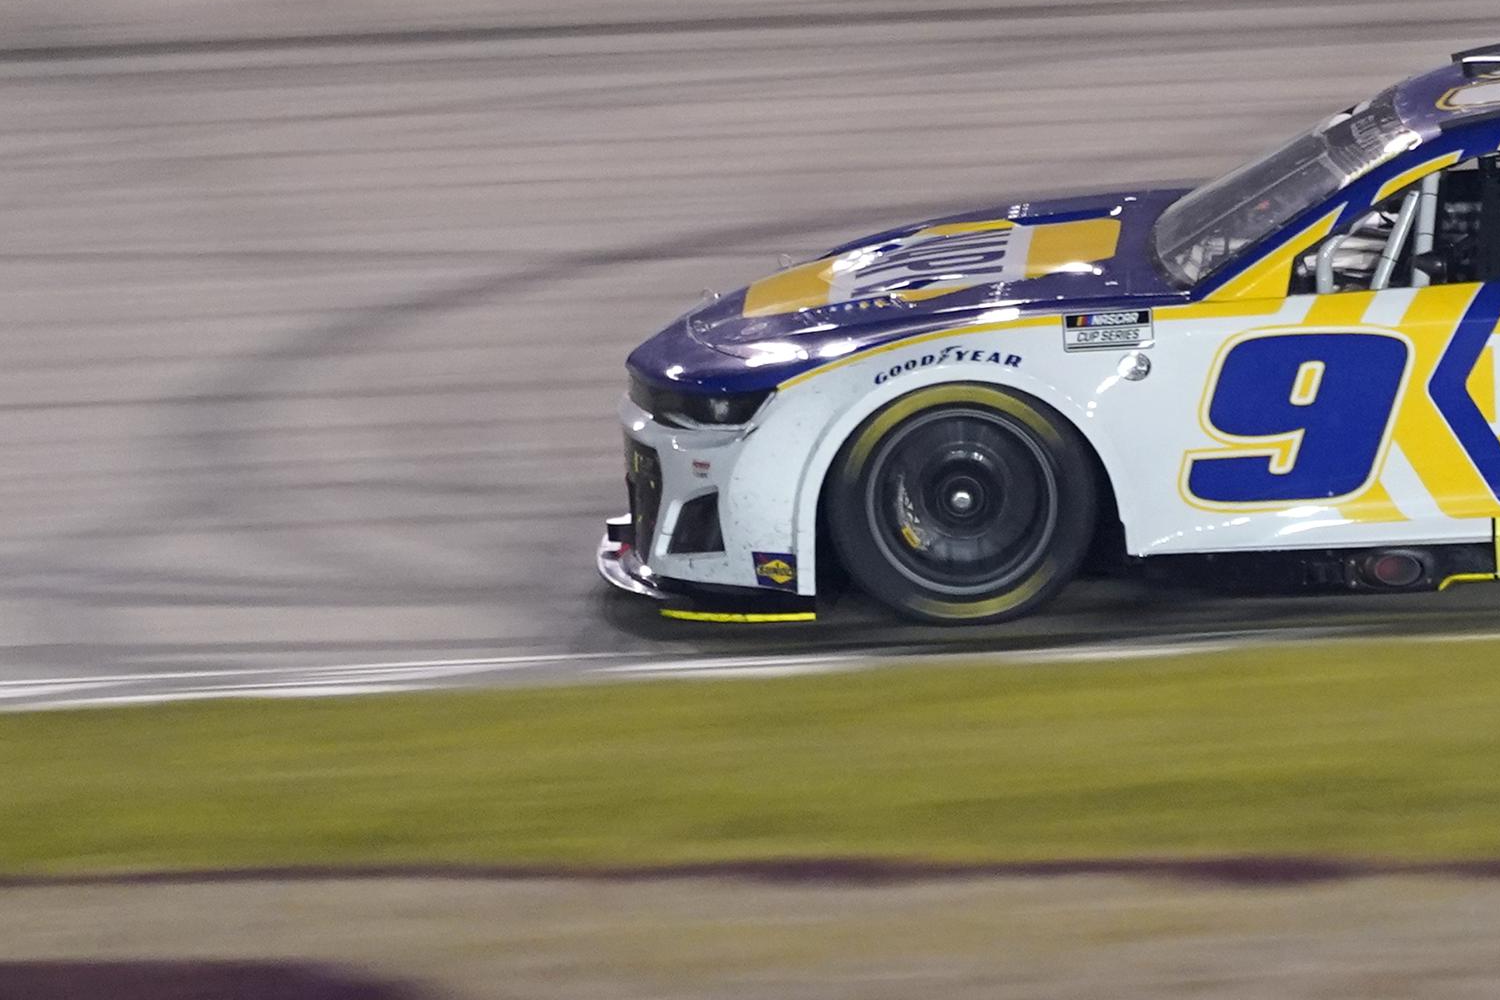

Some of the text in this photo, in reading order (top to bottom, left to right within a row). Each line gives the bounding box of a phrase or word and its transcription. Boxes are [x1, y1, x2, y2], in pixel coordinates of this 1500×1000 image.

[1092, 312, 1139, 326] NASCAR
[1077, 328, 1140, 342] CUP SERIES
[1178, 324, 1416, 513] 9
